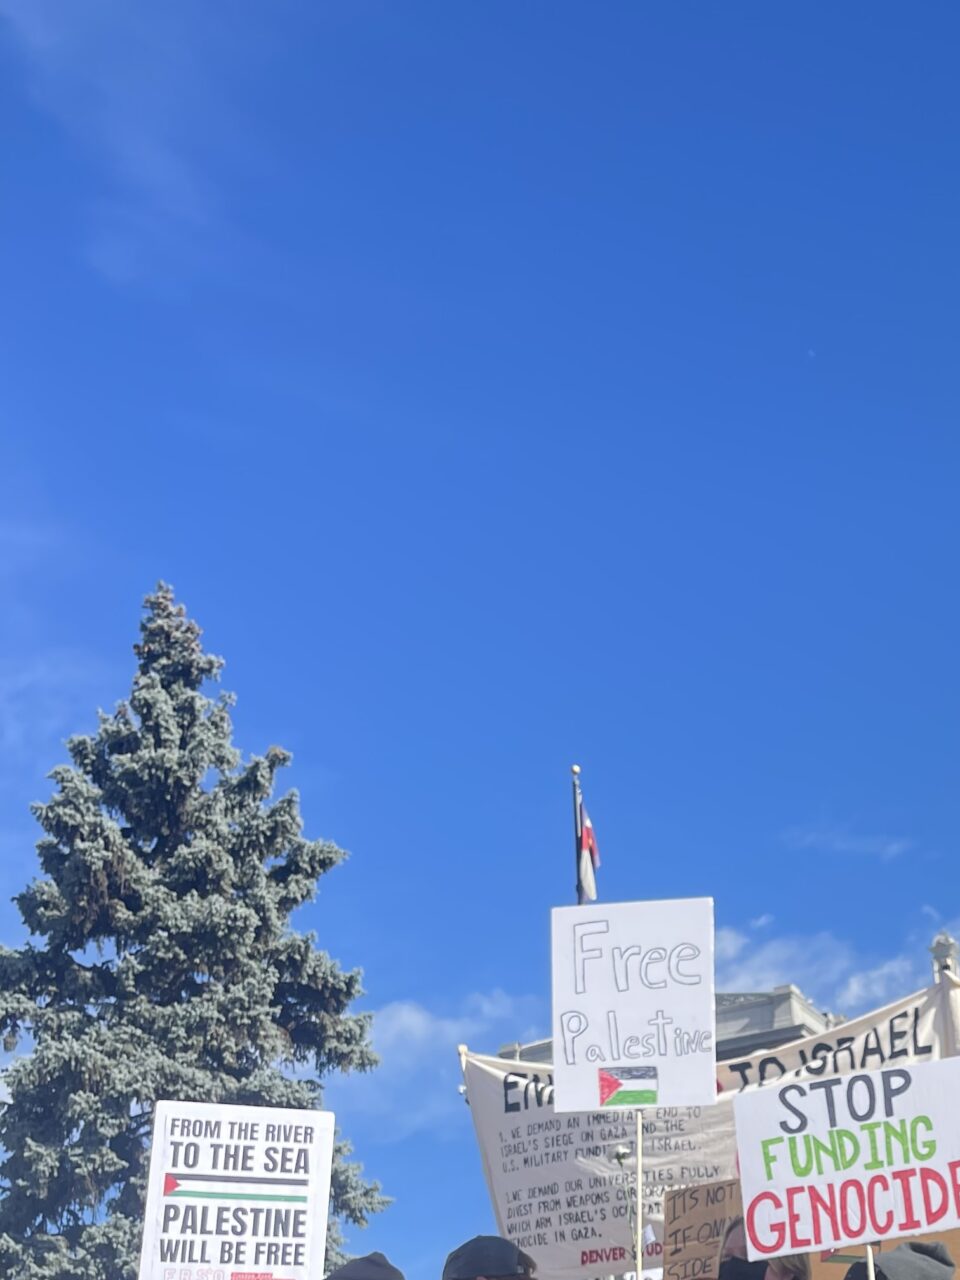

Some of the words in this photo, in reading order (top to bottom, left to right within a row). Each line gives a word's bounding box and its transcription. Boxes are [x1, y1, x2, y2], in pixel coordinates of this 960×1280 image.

[573, 920, 702, 994] Free
[795, 1007, 932, 1078] ISRAEL
[778, 1068, 911, 1134] STOP
[170, 1118, 222, 1139] FROM
[228, 1121, 259, 1141] THE
[265, 1124, 315, 1144] RIVER
[527, 1119, 562, 1137] DEMAND
[567, 1117, 580, 1129] AN
[587, 1109, 646, 1127] IMMEDIATE
[656, 1106, 678, 1120] END
[686, 1106, 702, 1119] TO
[501, 1139, 539, 1158] ISRAEL'S
[545, 1132, 574, 1149] SIEGE
[581, 1130, 594, 1142] ON
[600, 1127, 628, 1141] GAZA
[635, 1123, 657, 1135] ND
[664, 1119, 685, 1132] THE
[761, 1115, 937, 1181] FUNDING
[170, 1141, 199, 1169] TO
[210, 1143, 255, 1171] THE
[263, 1147, 310, 1174] SEA
[502, 1160, 520, 1174] U.S.
[524, 1150, 569, 1168] MILITARY
[575, 1144, 612, 1159] FUNDI
[650, 1137, 702, 1151] ISRAEL.
[527, 1182, 560, 1199] DEMAND
[565, 1179, 583, 1191] OUR
[588, 1168, 674, 1189] UNIVERSTIES
[681, 1165, 720, 1179] FULLY
[705, 1182, 737, 1205] NOT
[162, 1204, 308, 1238] PALESTINE
[506, 1203, 537, 1219] DIVEST
[538, 1198, 562, 1215] FROM
[566, 1192, 610, 1209] WEAPONS
[506, 1221, 531, 1235] WHICH
[535, 1217, 552, 1228] ARM
[559, 1208, 606, 1226] ISRAEL'S
[159, 1239, 211, 1264] WILL
[219, 1241, 247, 1265] BE
[254, 1243, 305, 1266] FREE
[510, 1233, 548, 1249] ENOCIDE
[555, 1231, 566, 1243] IN
[571, 1227, 602, 1240] GAZA.
[668, 1225, 692, 1256] IF
[581, 1247, 625, 1266] DENVER
